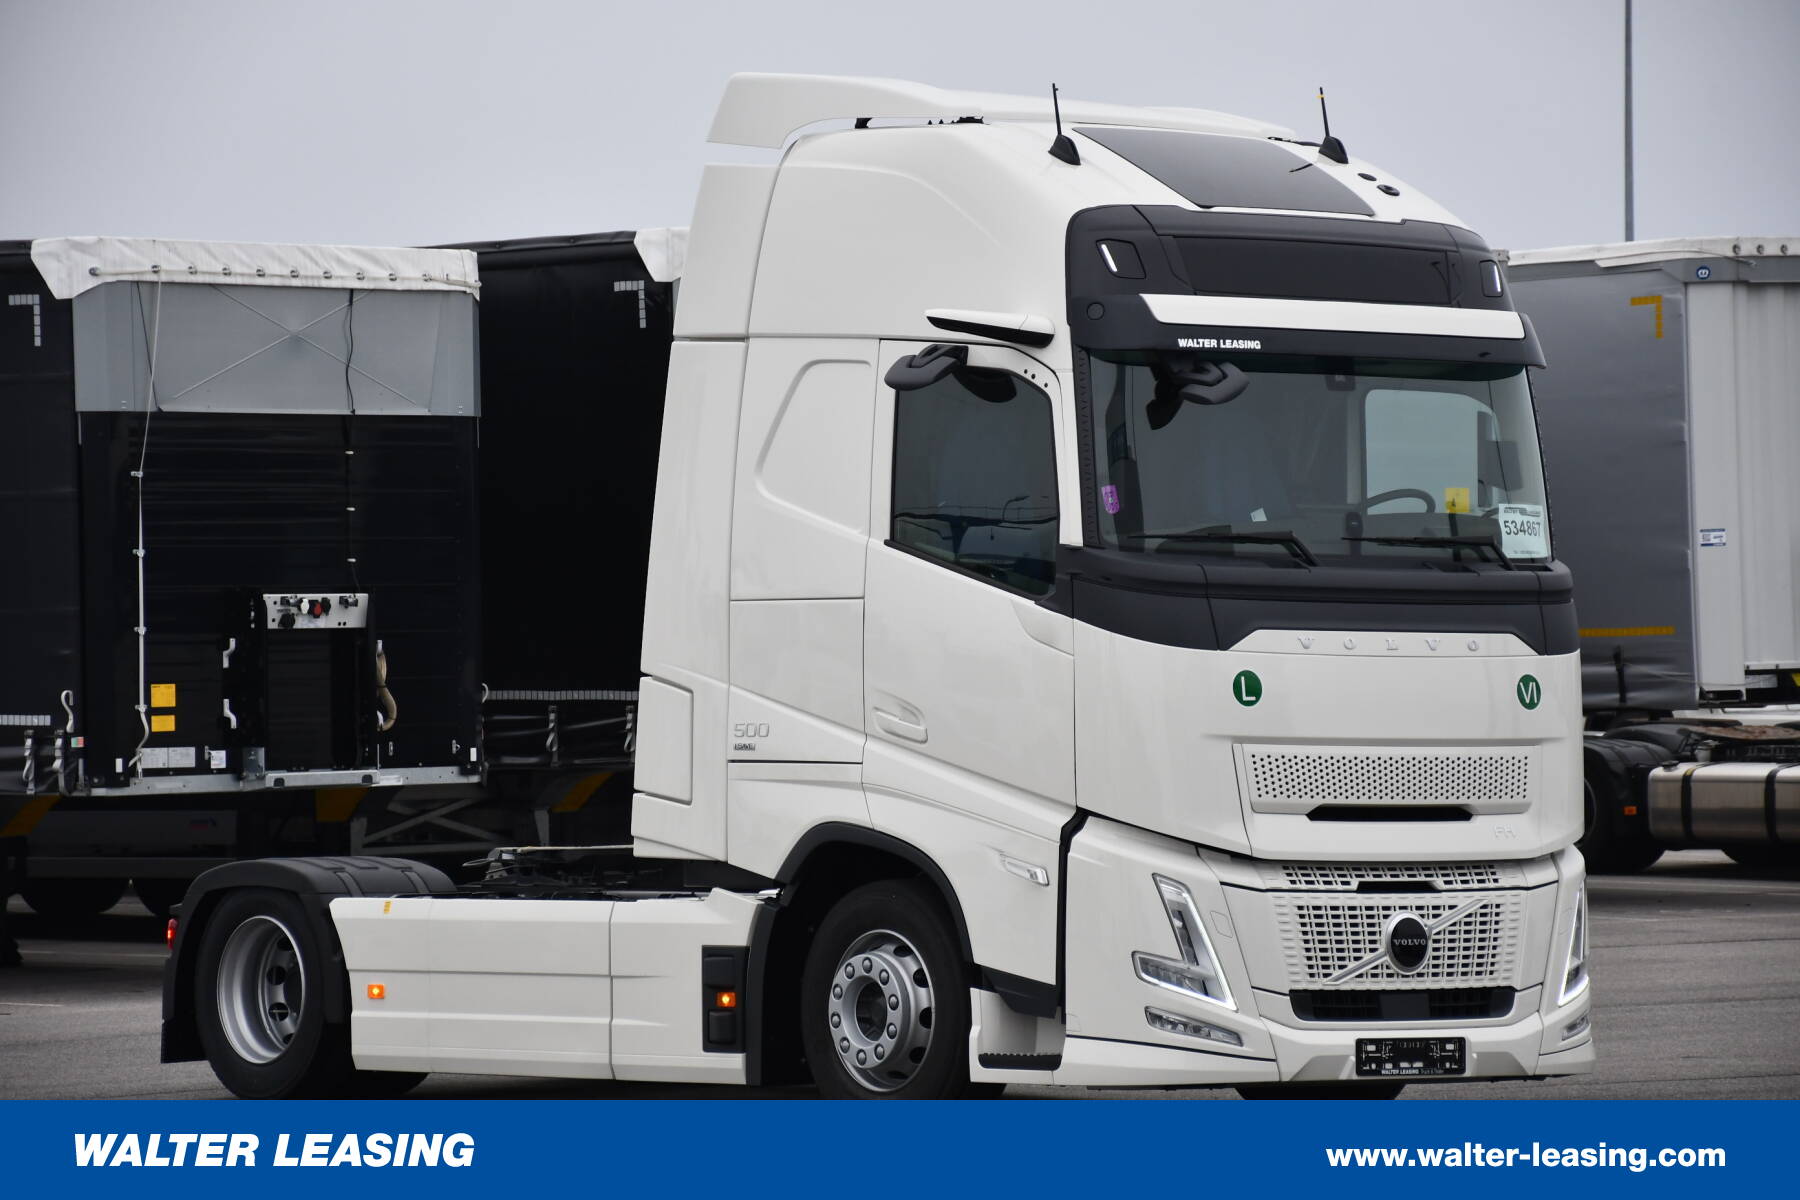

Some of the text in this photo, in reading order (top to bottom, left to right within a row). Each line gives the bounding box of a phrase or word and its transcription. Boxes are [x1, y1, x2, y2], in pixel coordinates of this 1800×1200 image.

[1177, 338, 1262, 350] WALTER LEASING
[1503, 520, 1541, 536] 534867
[1298, 637, 1480, 652] VOLVO
[1241, 676, 1257, 701] L
[734, 722, 770, 738] 500
[1393, 938, 1426, 946] VOLVO
